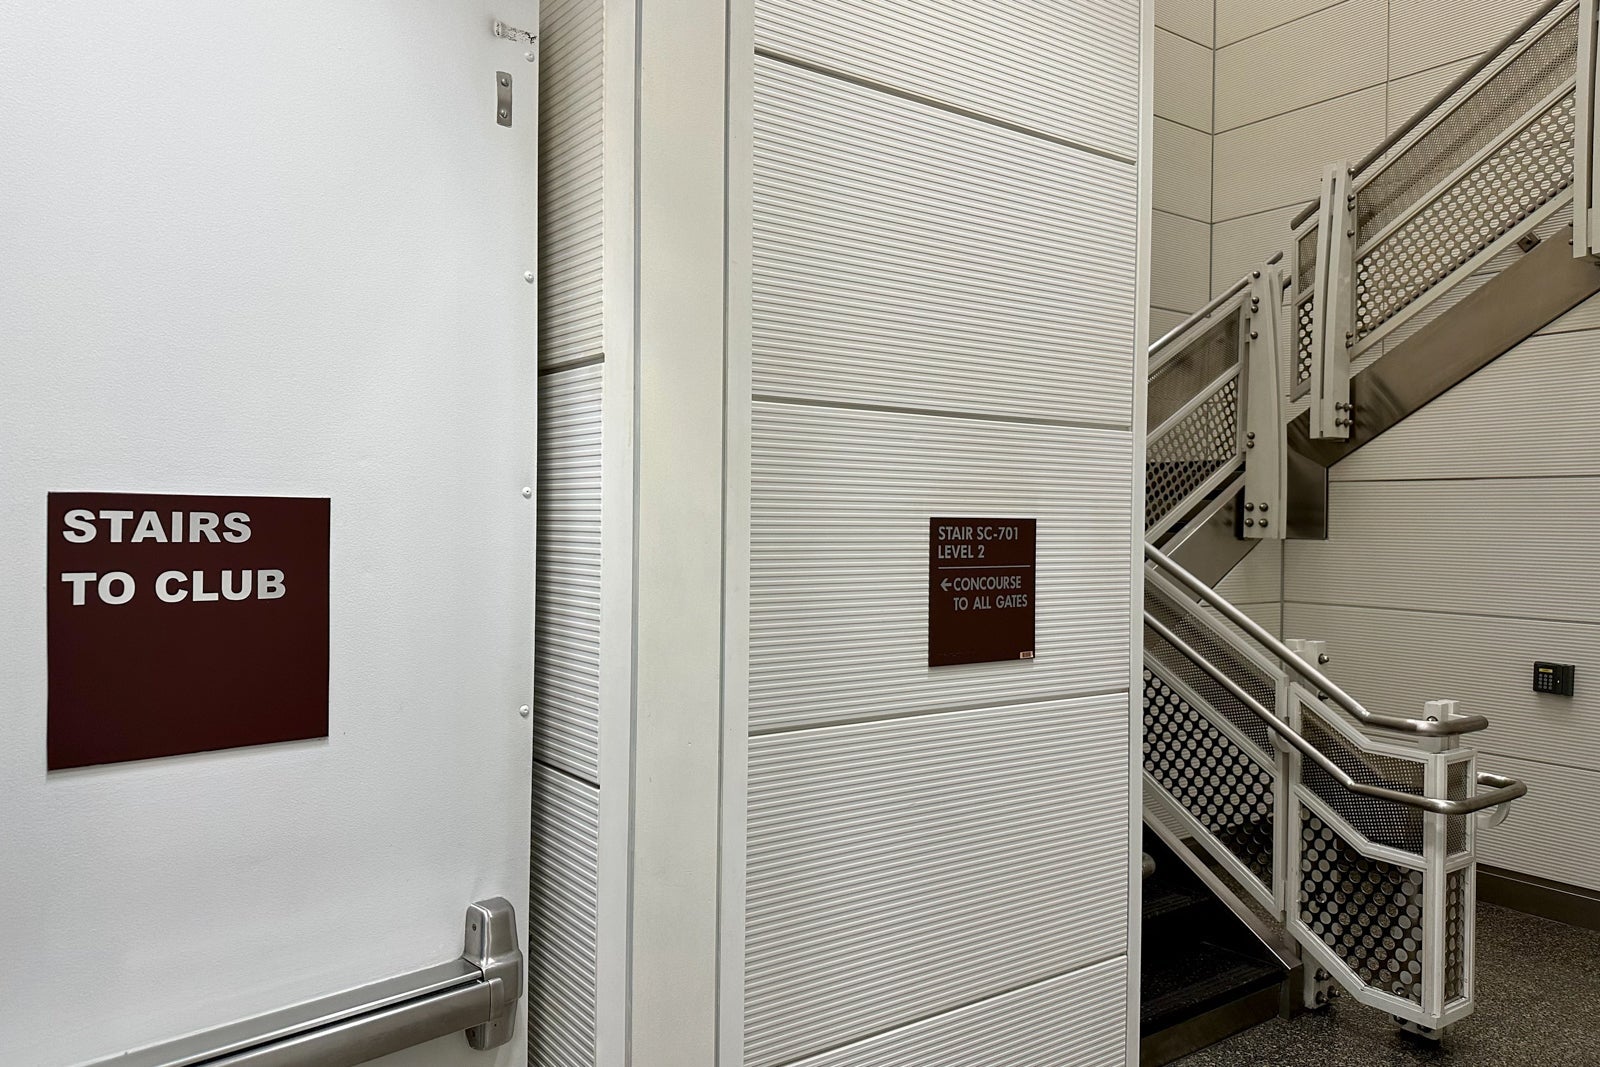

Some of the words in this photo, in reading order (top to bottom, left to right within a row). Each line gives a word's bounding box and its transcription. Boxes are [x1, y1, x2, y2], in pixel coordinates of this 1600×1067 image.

[62, 509, 252, 544] STAIRS
[938, 526, 973, 541] STAIR
[976, 526, 1019, 541] SC-701
[938, 544, 974, 559] LEVEL
[977, 544, 985, 559] 2
[61, 571, 136, 606] TO
[155, 569, 286, 603] CLUB
[953, 576, 1022, 592] CONCOURSE
[953, 596, 969, 611] TO
[973, 595, 992, 610] ALL
[995, 594, 1028, 609] GATES
